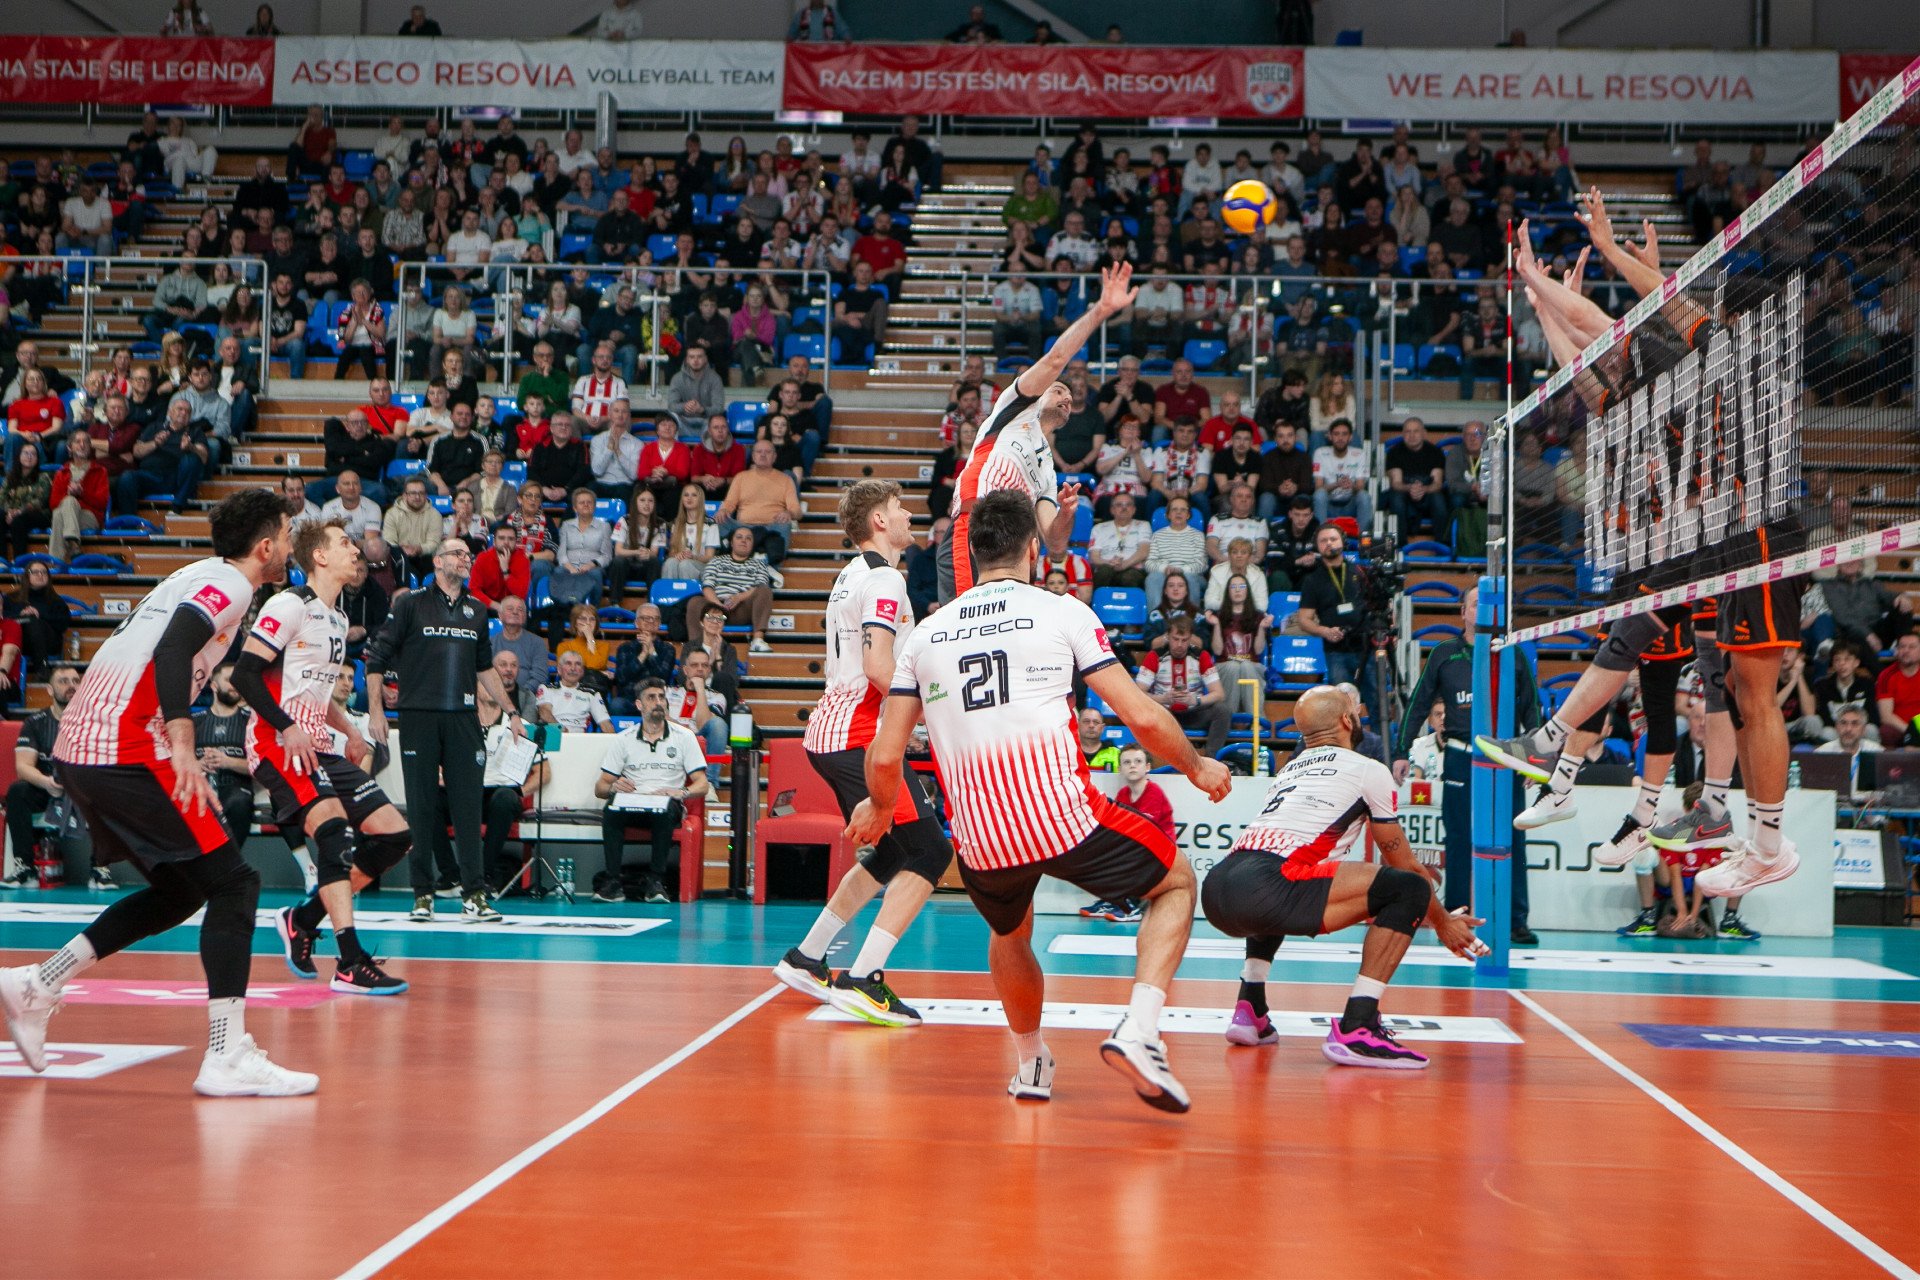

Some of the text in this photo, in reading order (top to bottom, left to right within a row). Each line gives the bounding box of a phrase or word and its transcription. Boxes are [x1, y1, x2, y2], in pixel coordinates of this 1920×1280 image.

[0, 59, 266, 88] IA STAJE SIĘ LEGENDĄ
[291, 60, 775, 88] ASSECO RESOVIA VOLLEYBALL TEAM
[818, 69, 1216, 96] RAZEM JESTEŚMY SIŁĄ. RESOVIA!
[1387, 73, 1755, 101] WE ARE ALL RESOVIA
[959, 599, 1007, 620] BUTRYN
[423, 625, 478, 640] asseco
[931, 618, 1034, 644] asseco
[328, 636, 344, 664] 12
[958, 649, 1011, 713] 21
